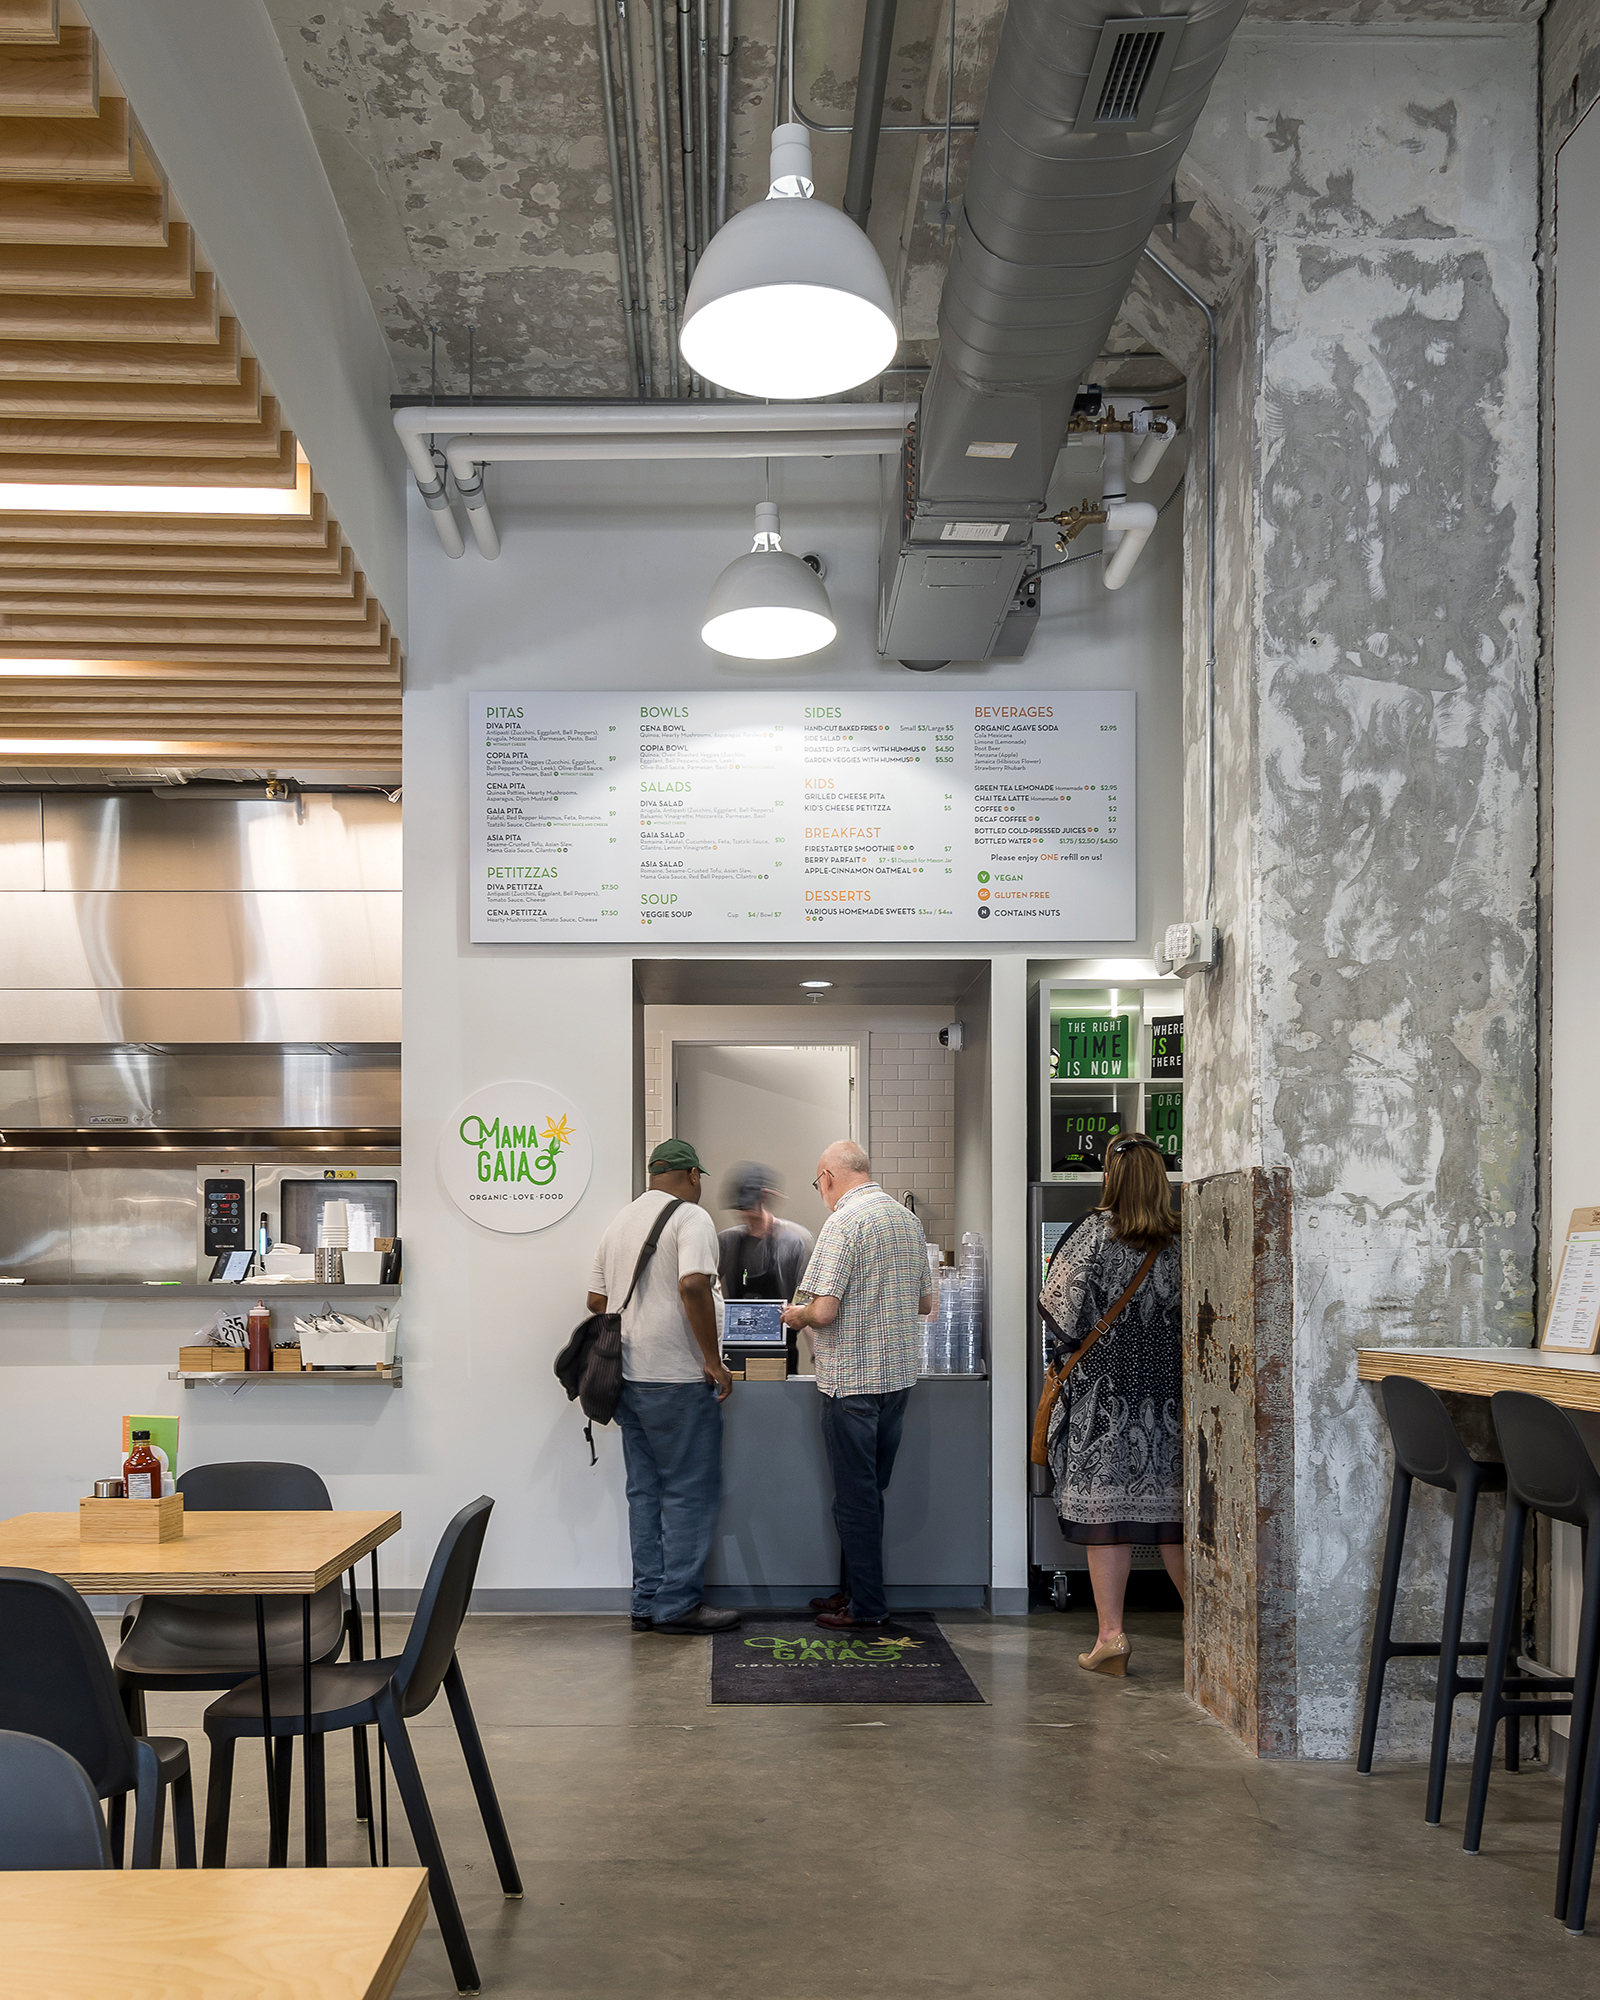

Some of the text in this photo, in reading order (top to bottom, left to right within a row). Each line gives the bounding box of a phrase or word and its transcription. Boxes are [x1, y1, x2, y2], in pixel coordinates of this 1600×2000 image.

[486, 707, 524, 718] PITAS
[640, 707, 689, 718] BOWLS
[805, 707, 842, 718] SIDES
[975, 707, 1053, 718] BEVERAGES
[640, 781, 692, 792] SALADS
[805, 778, 834, 789] KIDS
[805, 827, 881, 838] BREAKFAST
[1018, 854, 1038, 862] enjoy
[487, 867, 558, 878] PETITZZAS
[641, 894, 678, 905] SOUP
[805, 891, 871, 901] DESSERTS
[1068, 1020, 1122, 1033] THE RIGHT
[1068, 1034, 1121, 1058] TIME
[1152, 1056, 1182, 1067] THERE
[1066, 1060, 1122, 1076] IS NOW
[1066, 1116, 1106, 1132] FOOD
[1078, 1135, 1093, 1150] IS
[478, 1150, 557, 1186] GAIA
[773, 1647, 902, 1662] GAIA
